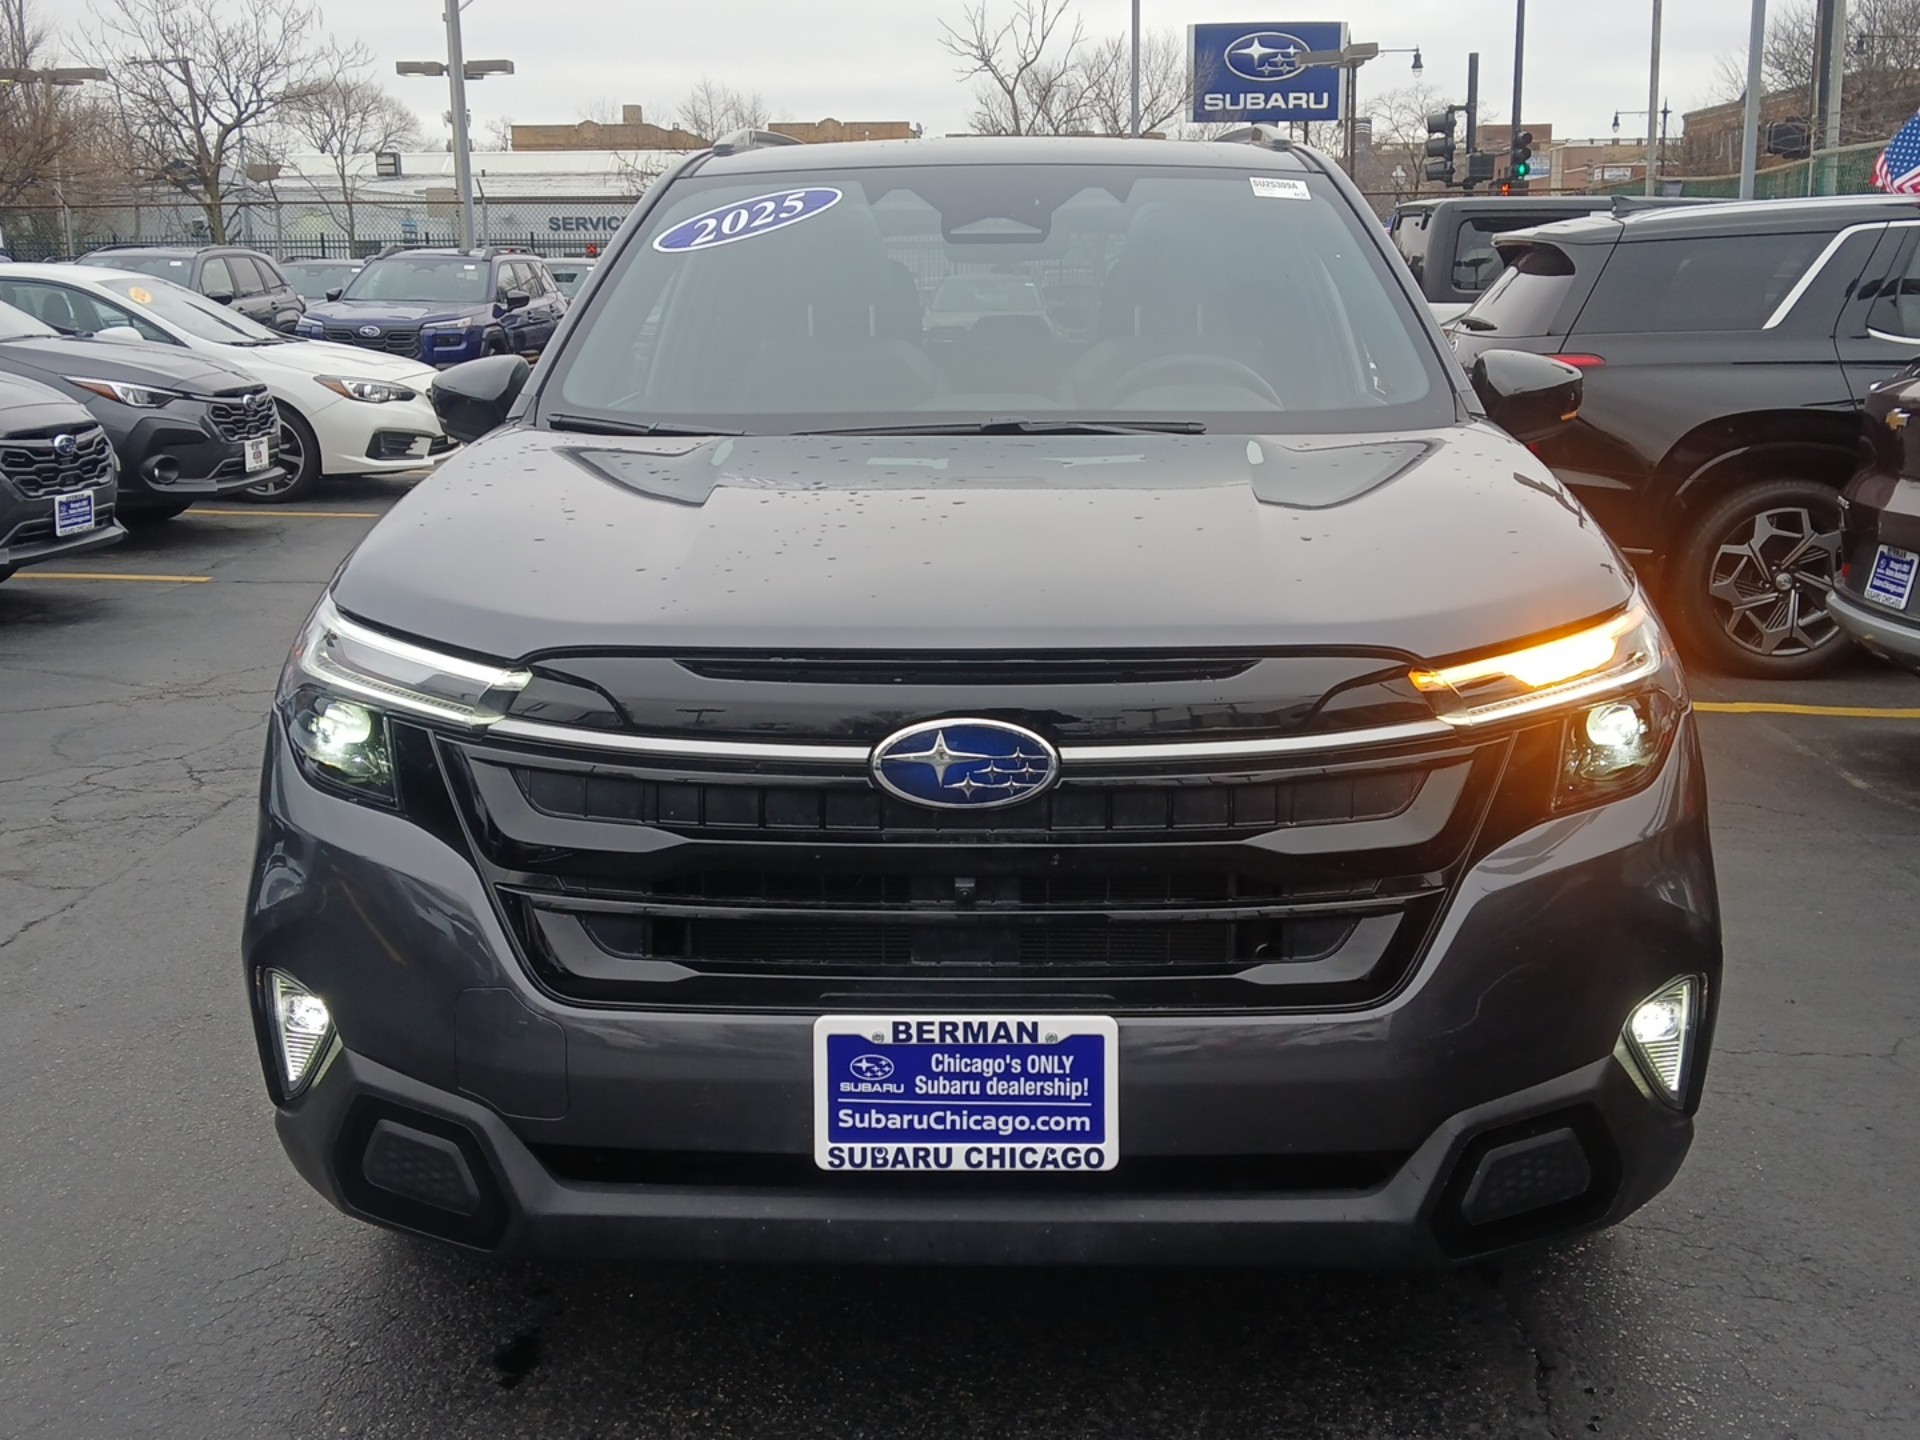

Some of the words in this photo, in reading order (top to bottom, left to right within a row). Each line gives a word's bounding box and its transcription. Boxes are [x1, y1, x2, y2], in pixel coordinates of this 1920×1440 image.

[1204, 92, 1329, 111] SUBARU
[690, 191, 807, 247] 2025
[892, 1021, 1039, 1044] BERMAN
[931, 1053, 1022, 1077] Chicago's
[1027, 1054, 1075, 1074] ONLY
[839, 1081, 905, 1093] SUBARU
[915, 1075, 981, 1095] Subaru
[986, 1076, 1089, 1101] dealership!
[838, 1108, 1091, 1136] SubaruChicago.com
[827, 1147, 953, 1169] SUBARU
[964, 1147, 1105, 1169] CHICAGO
